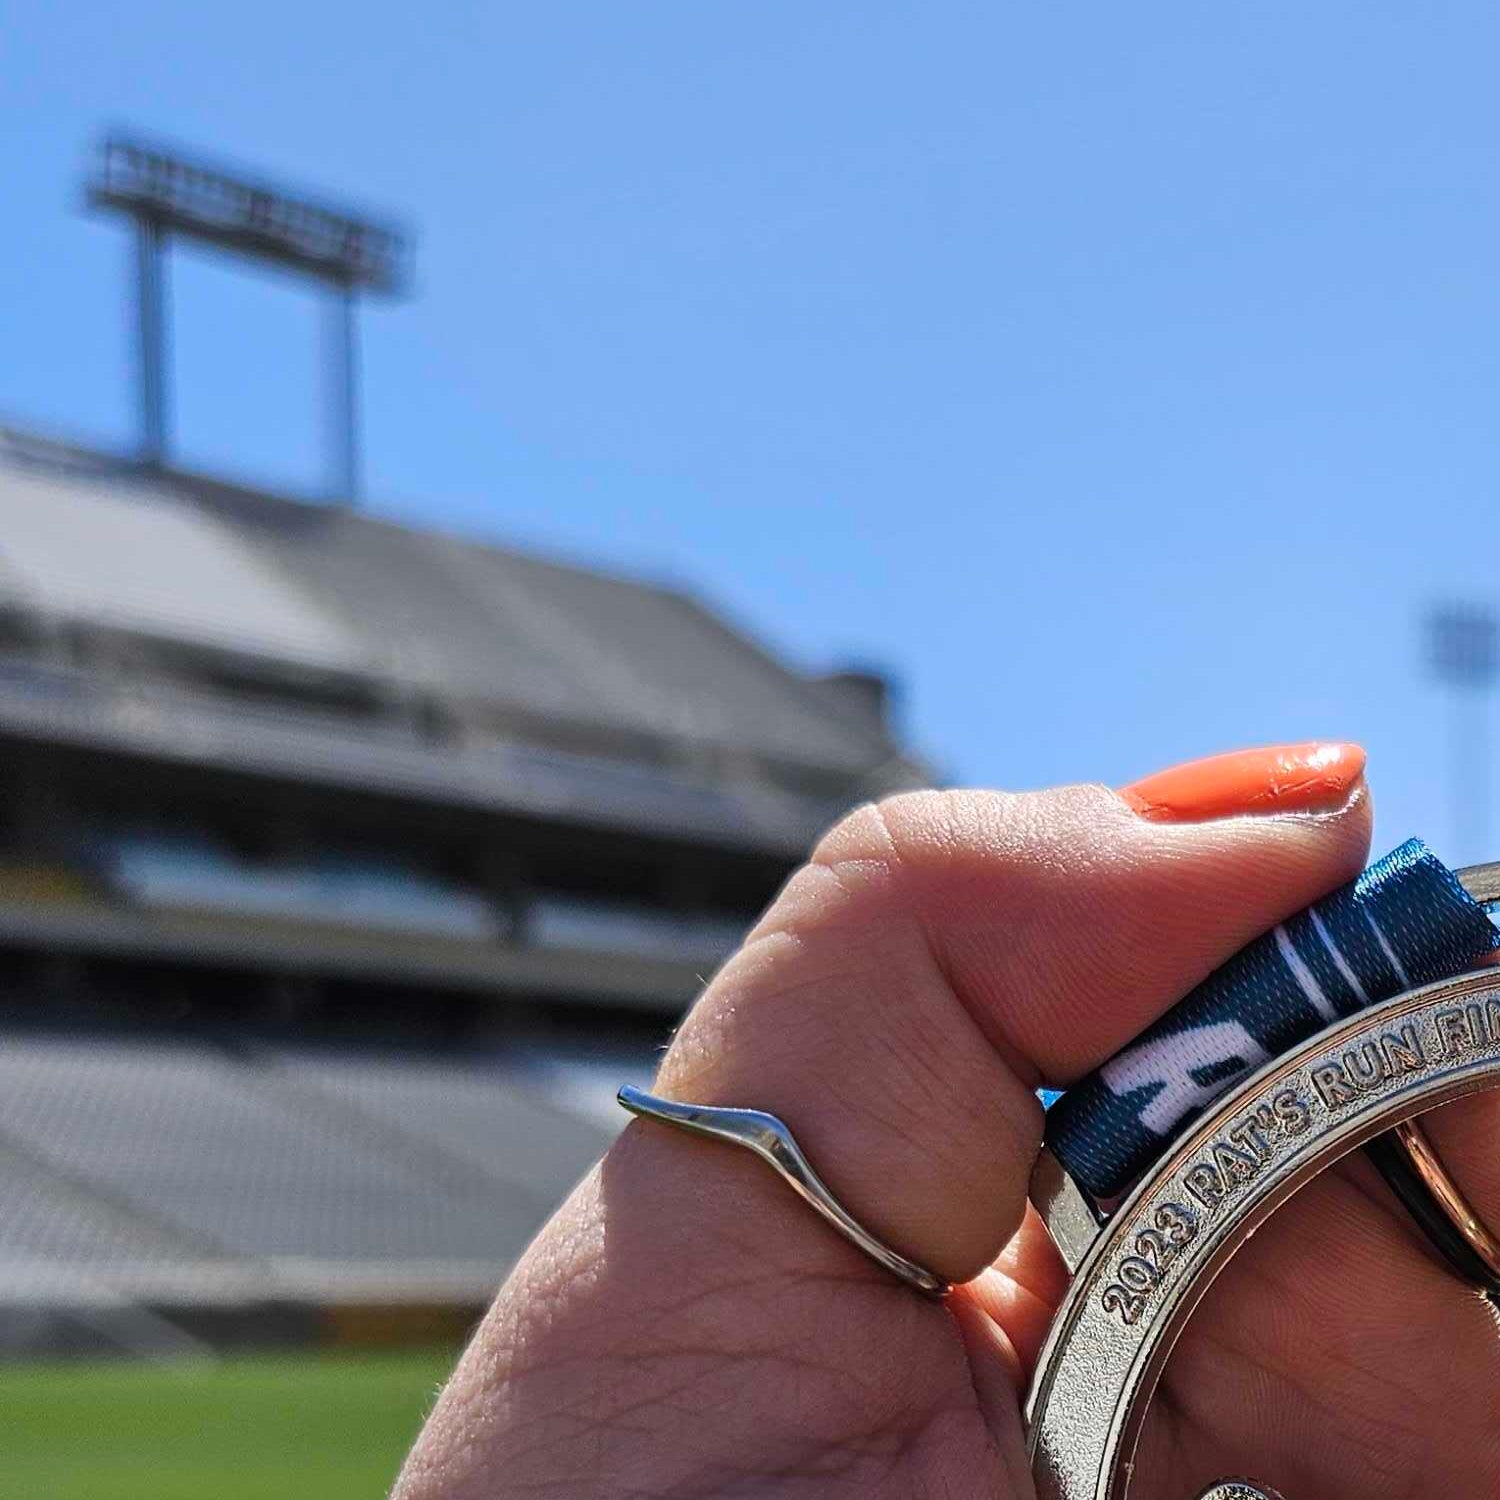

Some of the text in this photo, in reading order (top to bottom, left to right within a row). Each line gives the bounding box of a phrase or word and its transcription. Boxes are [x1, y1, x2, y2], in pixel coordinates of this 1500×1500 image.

[1103, 1202, 1199, 1326] 2023
[1184, 1089, 1312, 1209] PAT'S
[1311, 1024, 1427, 1112] RUN
